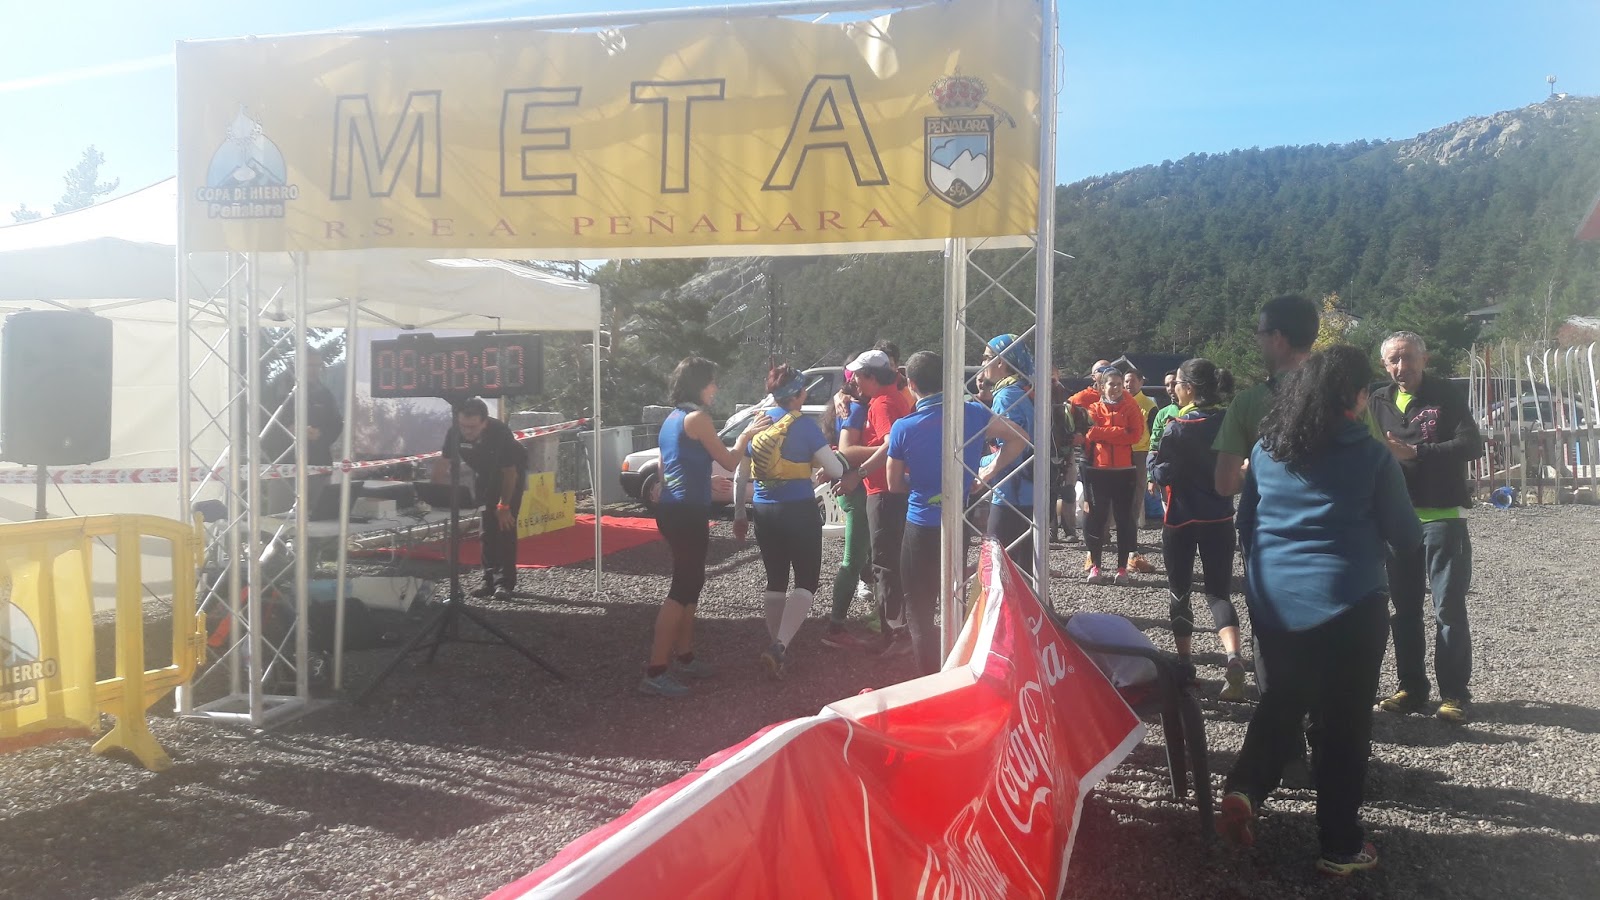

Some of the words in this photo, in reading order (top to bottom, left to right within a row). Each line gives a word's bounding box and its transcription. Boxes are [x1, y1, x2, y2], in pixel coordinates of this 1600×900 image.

[329, 74, 890, 201] META
[197, 187, 230, 201] COPA
[250, 184, 299, 201] HIERRO
[949, 182, 968, 197] SEA
[210, 201, 285, 218] Peñalara
[572, 207, 894, 237] PEÑALARA
